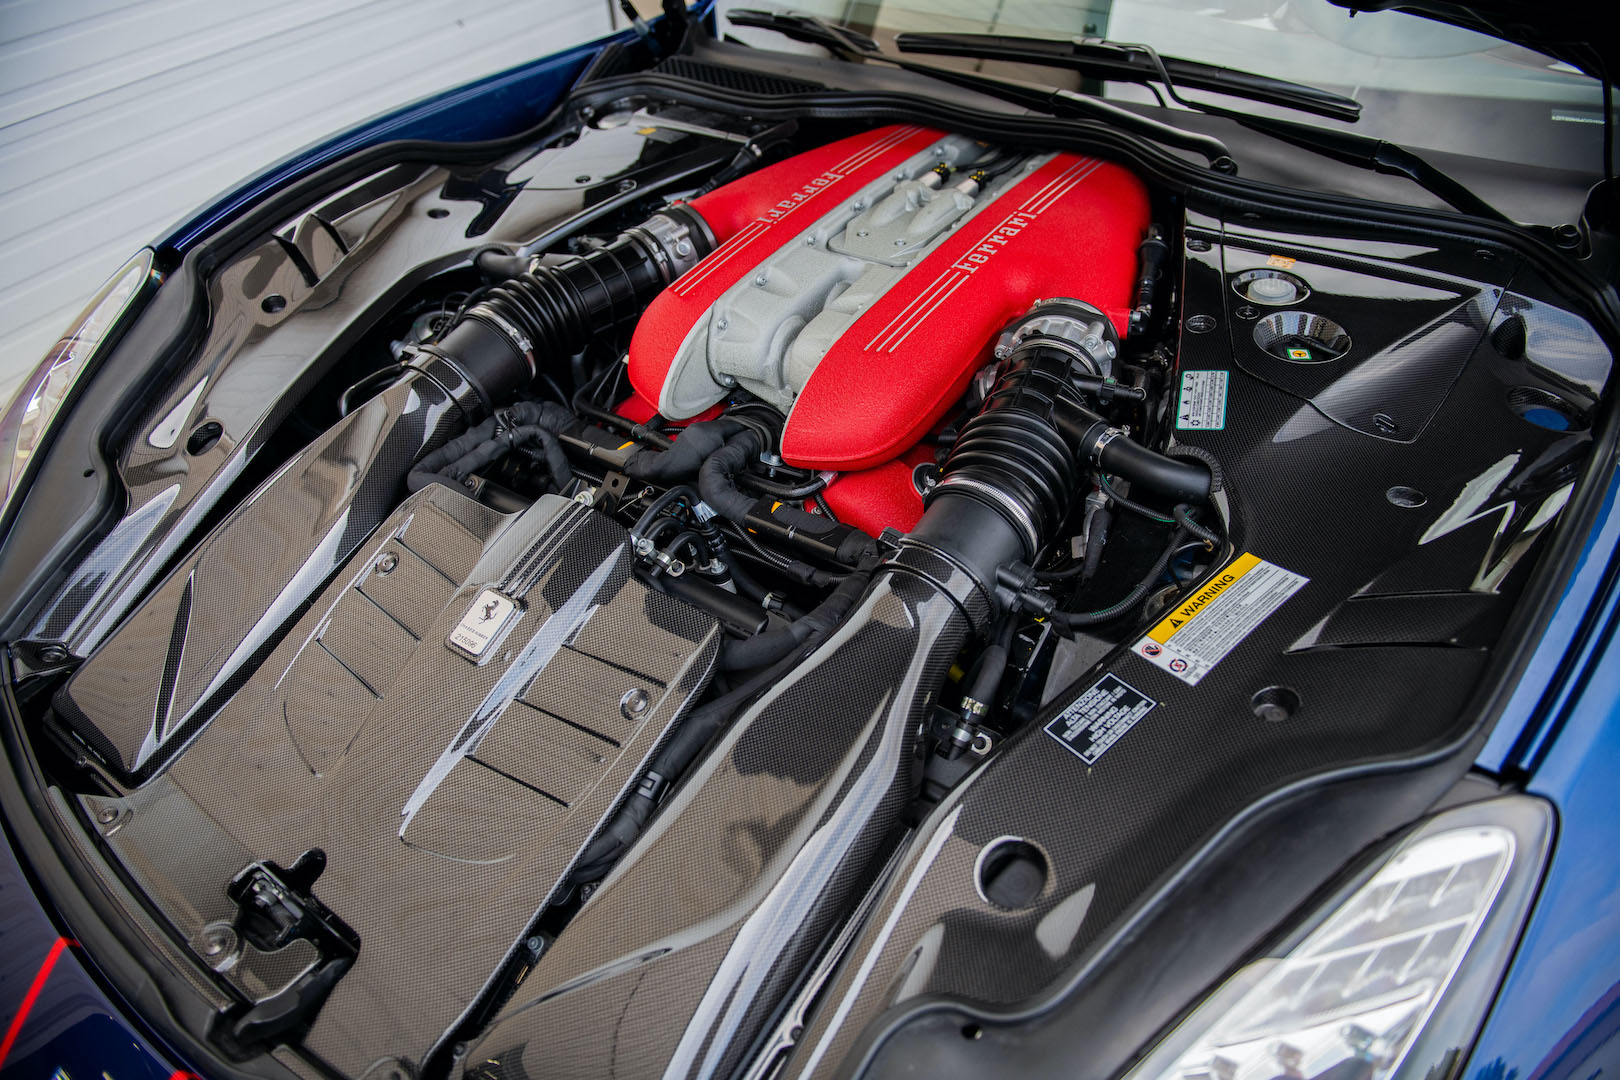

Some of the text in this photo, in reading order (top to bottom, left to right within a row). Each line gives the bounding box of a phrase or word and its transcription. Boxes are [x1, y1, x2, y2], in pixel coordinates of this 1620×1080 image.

[756, 171, 845, 225] Ferrari
[951, 210, 1037, 274] Ferrari
[1180, 573, 1235, 614] WARNING
[1063, 687, 1101, 720] ATTENZIONE
[1065, 688, 1110, 727] ALTA TENSIONE
[1103, 705, 1131, 729] VOLTAGE
